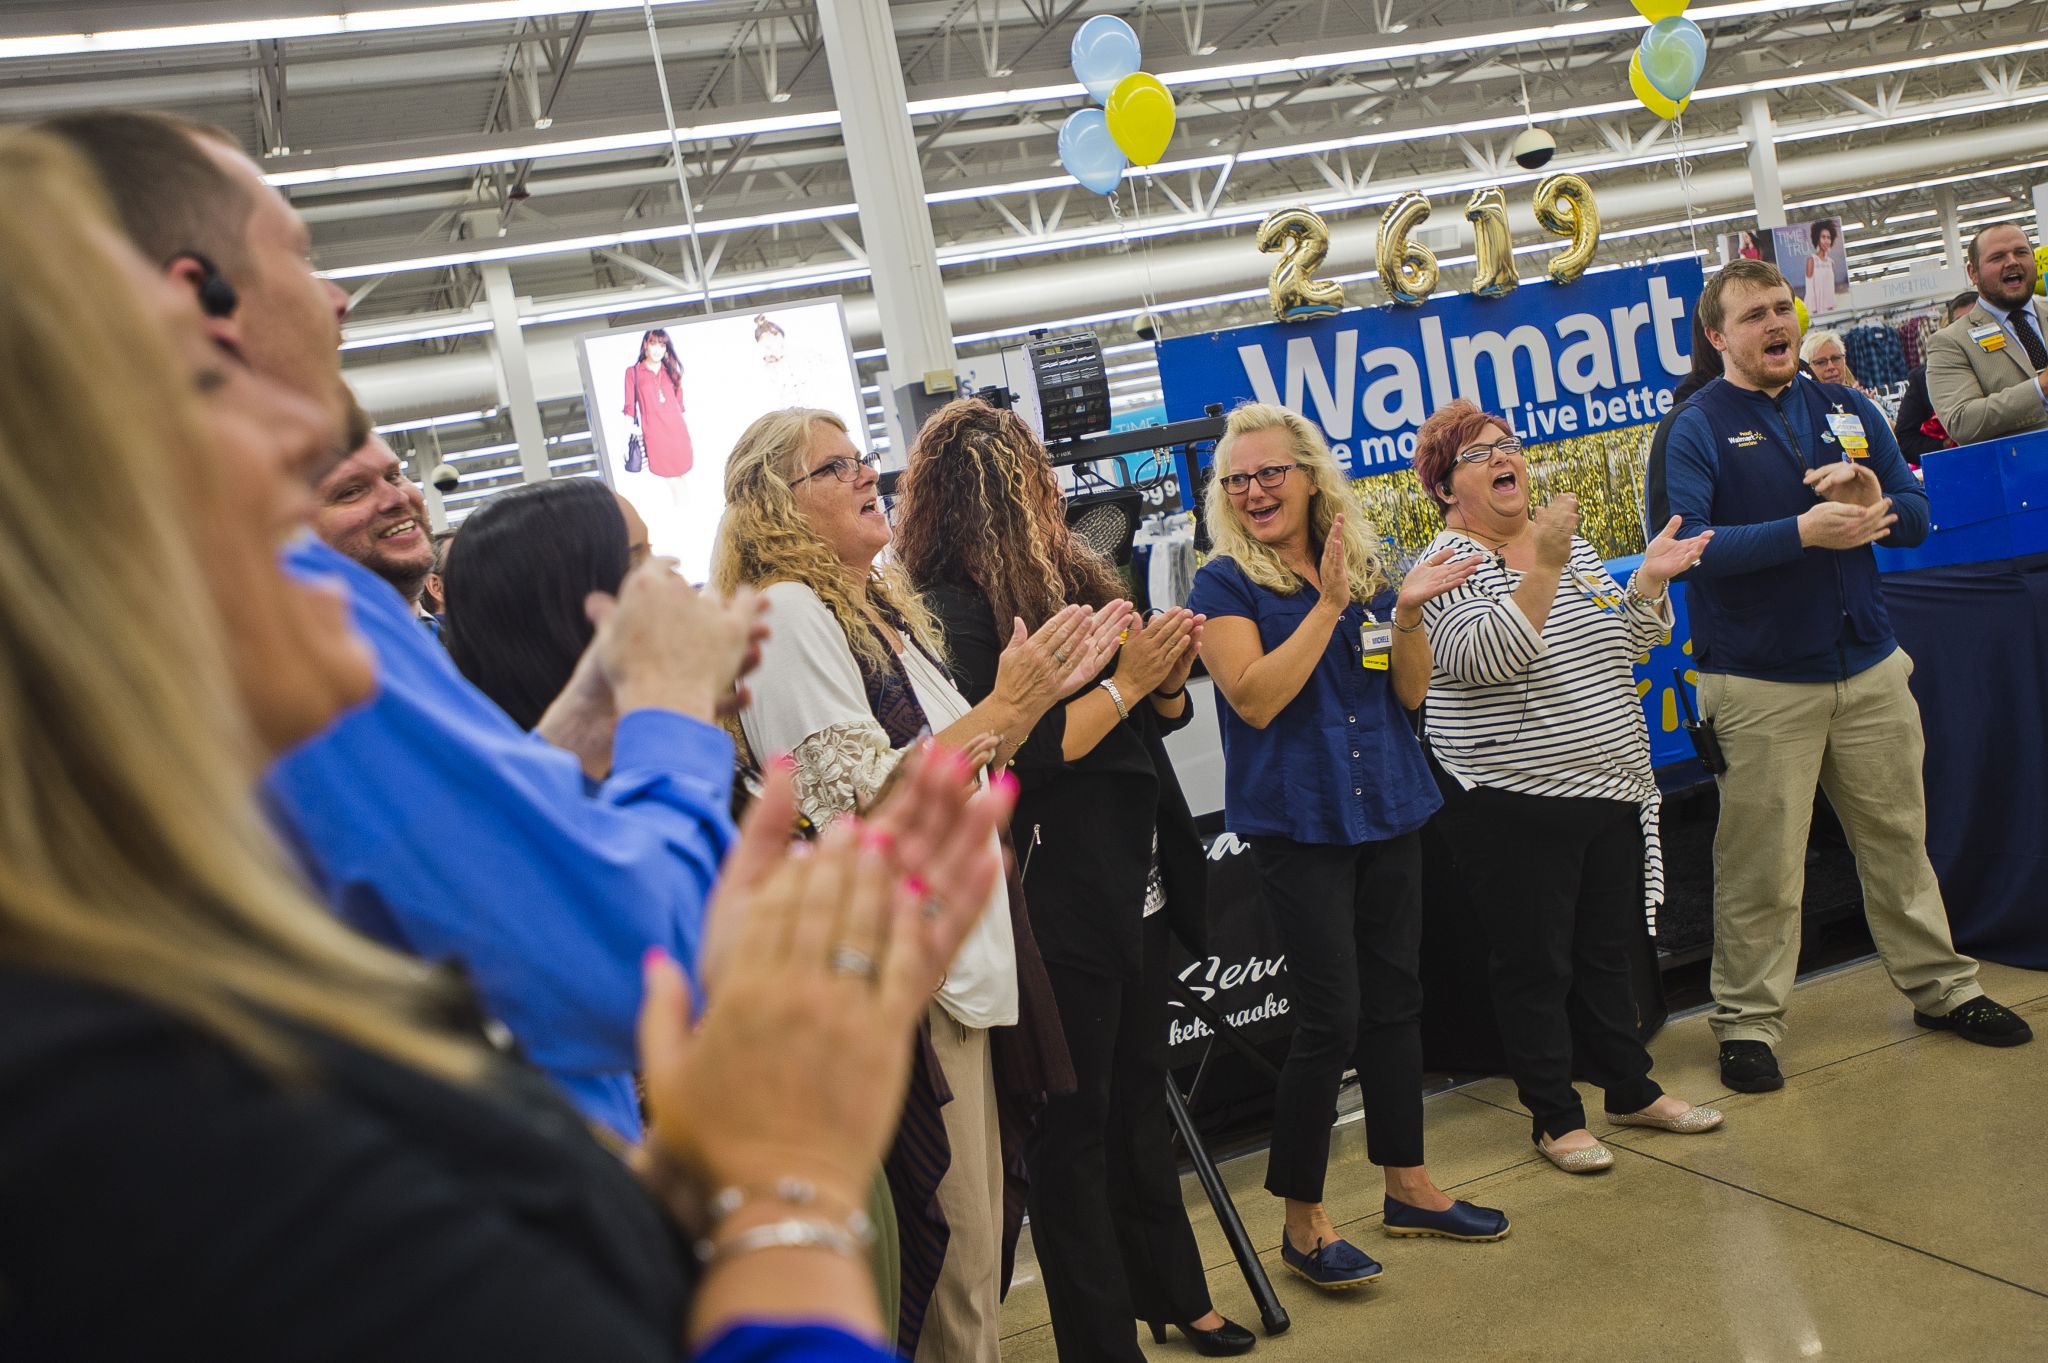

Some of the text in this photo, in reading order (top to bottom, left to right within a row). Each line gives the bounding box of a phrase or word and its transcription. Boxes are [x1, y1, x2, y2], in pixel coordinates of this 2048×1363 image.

[1237, 276, 1692, 441] Walmart
[1505, 402, 1577, 439] Live
[1583, 385, 1673, 428] bette
[1168, 954, 1288, 1007] Serv
